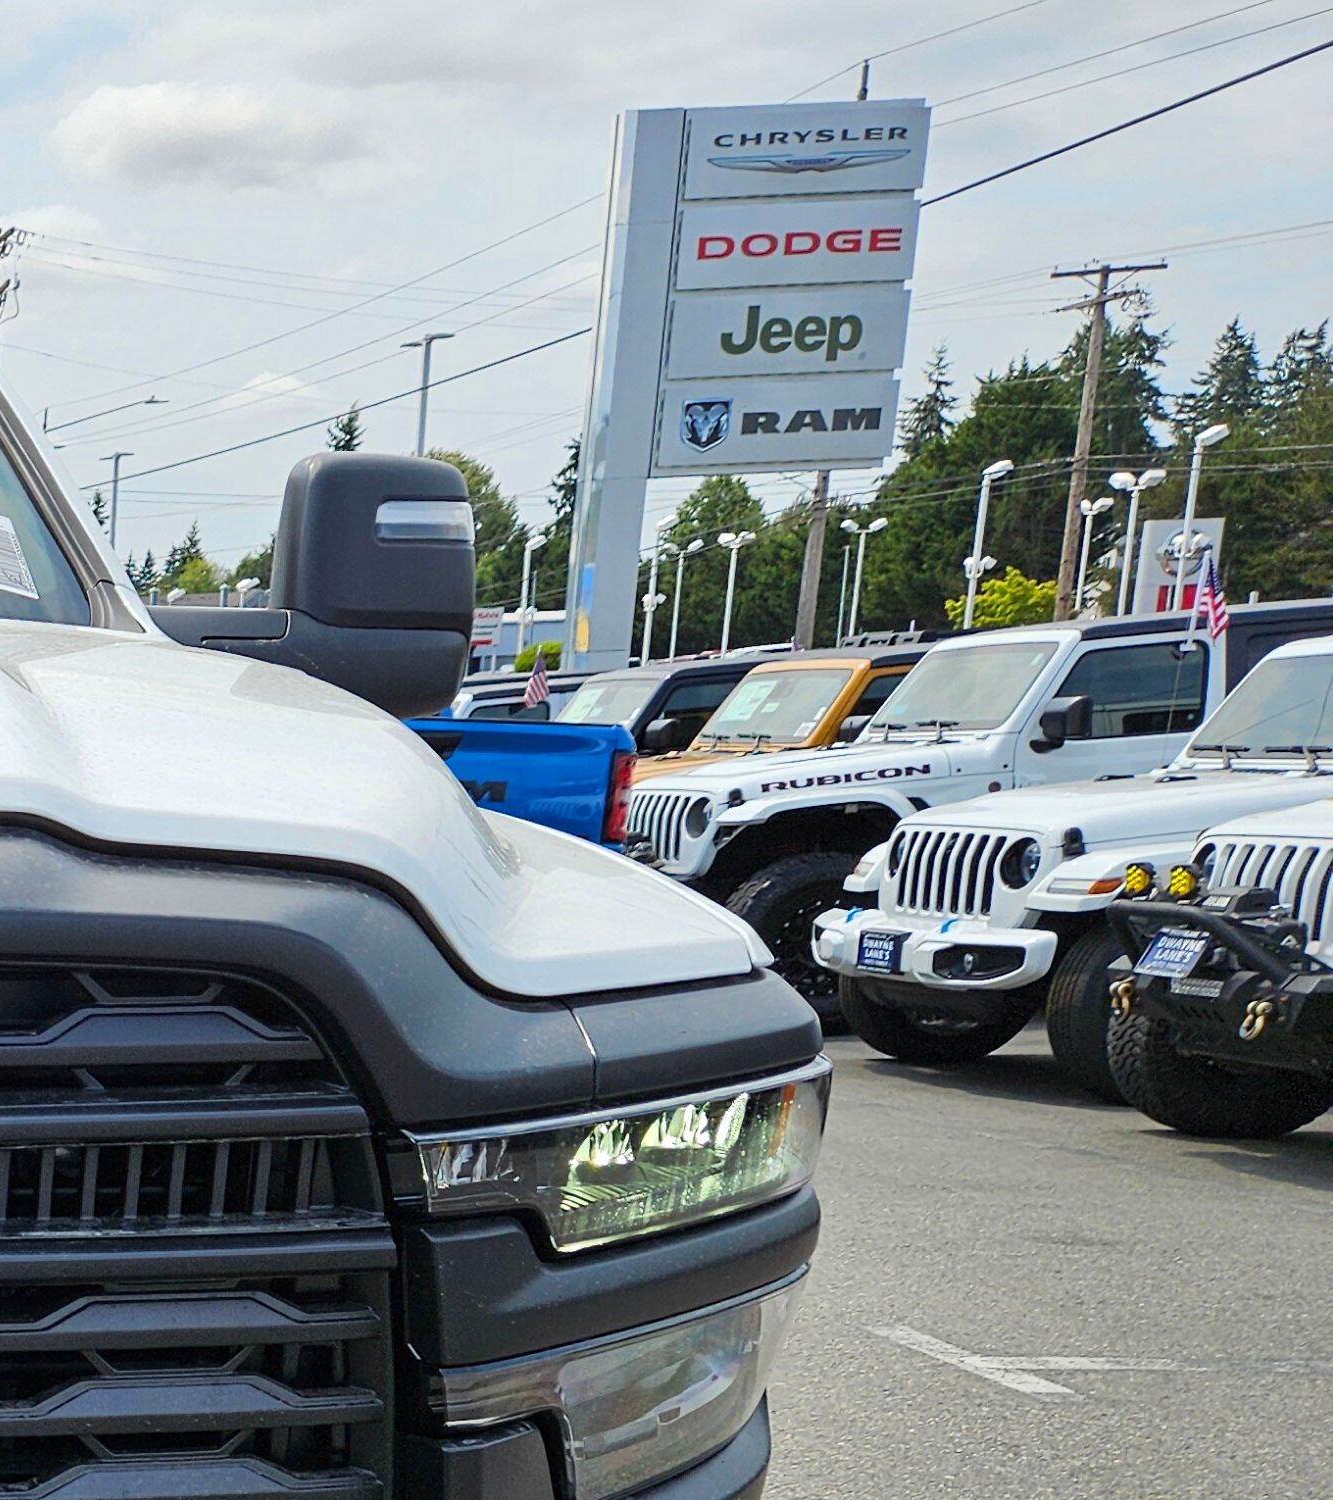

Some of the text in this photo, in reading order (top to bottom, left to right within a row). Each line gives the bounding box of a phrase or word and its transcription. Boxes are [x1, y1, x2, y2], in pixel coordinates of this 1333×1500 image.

[714, 126, 909, 148] CHRYSLER
[696, 228, 903, 261] DODGE
[720, 304, 864, 362] Jeep
[740, 407, 883, 436] RAM
[760, 764, 931, 793] RUBICON
[1156, 936, 1206, 953] DWAYNE
